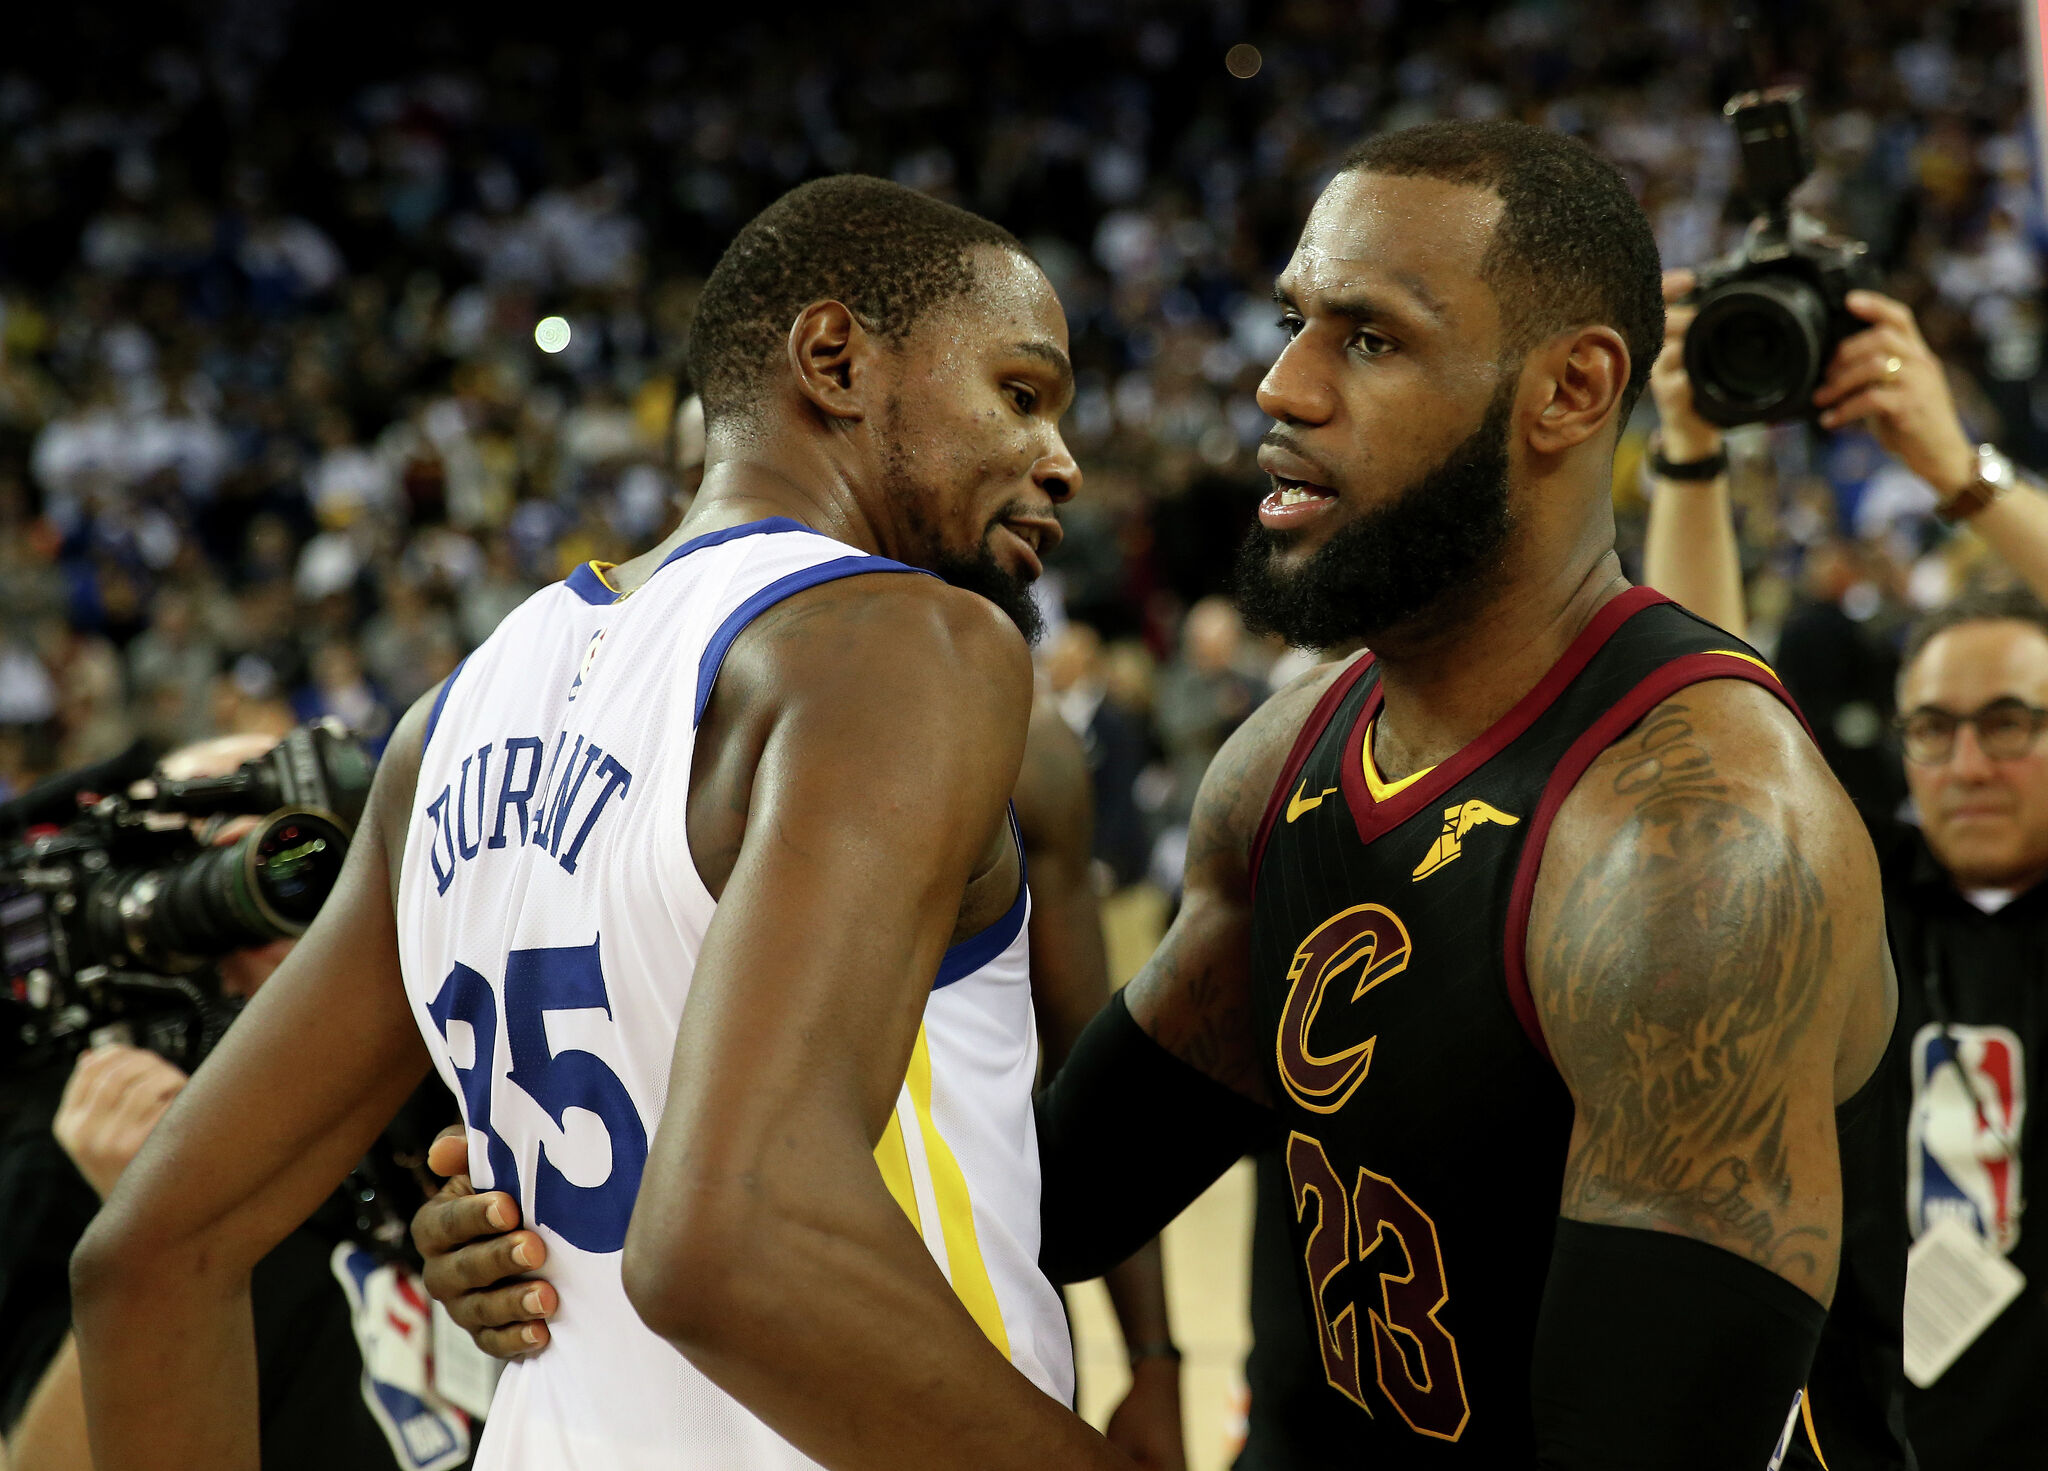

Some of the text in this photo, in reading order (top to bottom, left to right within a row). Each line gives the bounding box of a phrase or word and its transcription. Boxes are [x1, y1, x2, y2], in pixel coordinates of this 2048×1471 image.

[427, 731, 633, 898] DURANT
[426, 931, 649, 1254] 35
[1277, 902, 1412, 1114] C
[1286, 1130, 1471, 1443] 23
